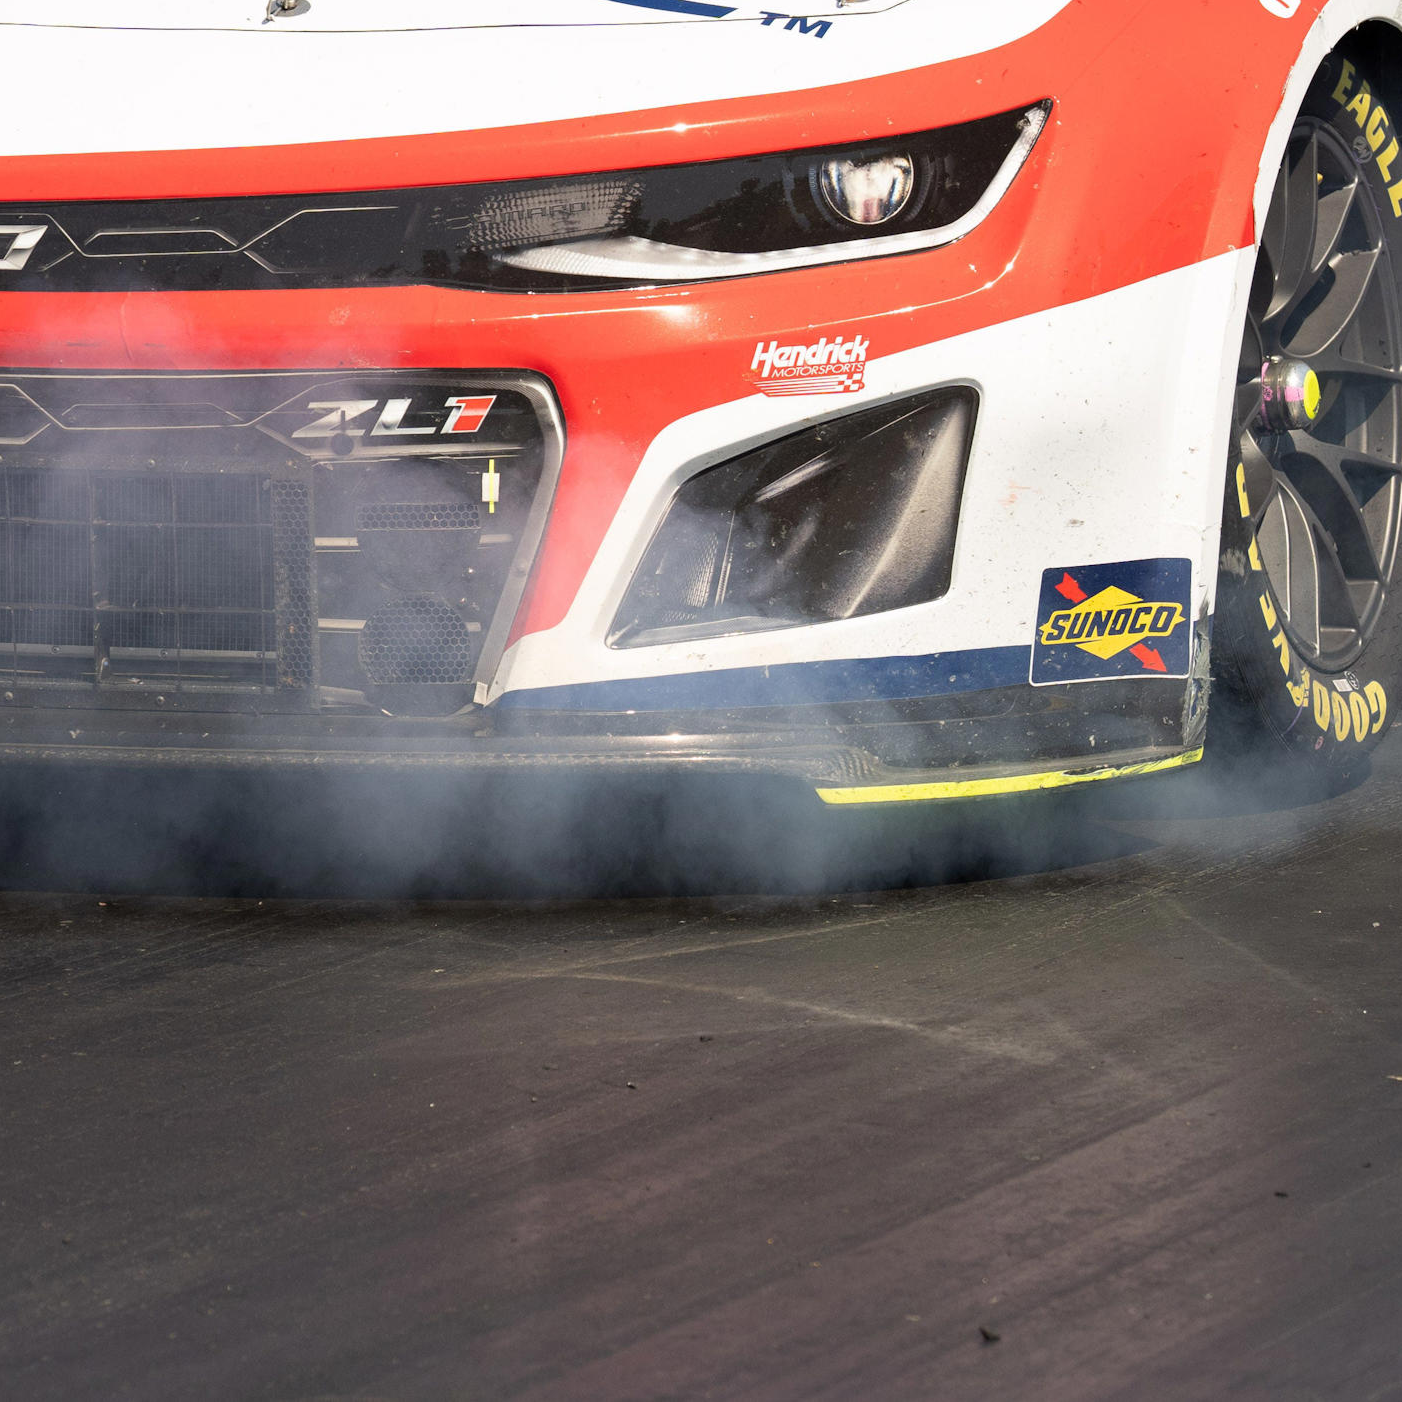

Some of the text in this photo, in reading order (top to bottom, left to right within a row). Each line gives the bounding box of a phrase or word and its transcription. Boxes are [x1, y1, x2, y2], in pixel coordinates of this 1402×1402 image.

[750, 335, 869, 378] Hendrick
[771, 361, 864, 378] MOTORSPORTS
[291, 395, 497, 438] ZL1
[1045, 605, 1178, 642] SUNOCO
